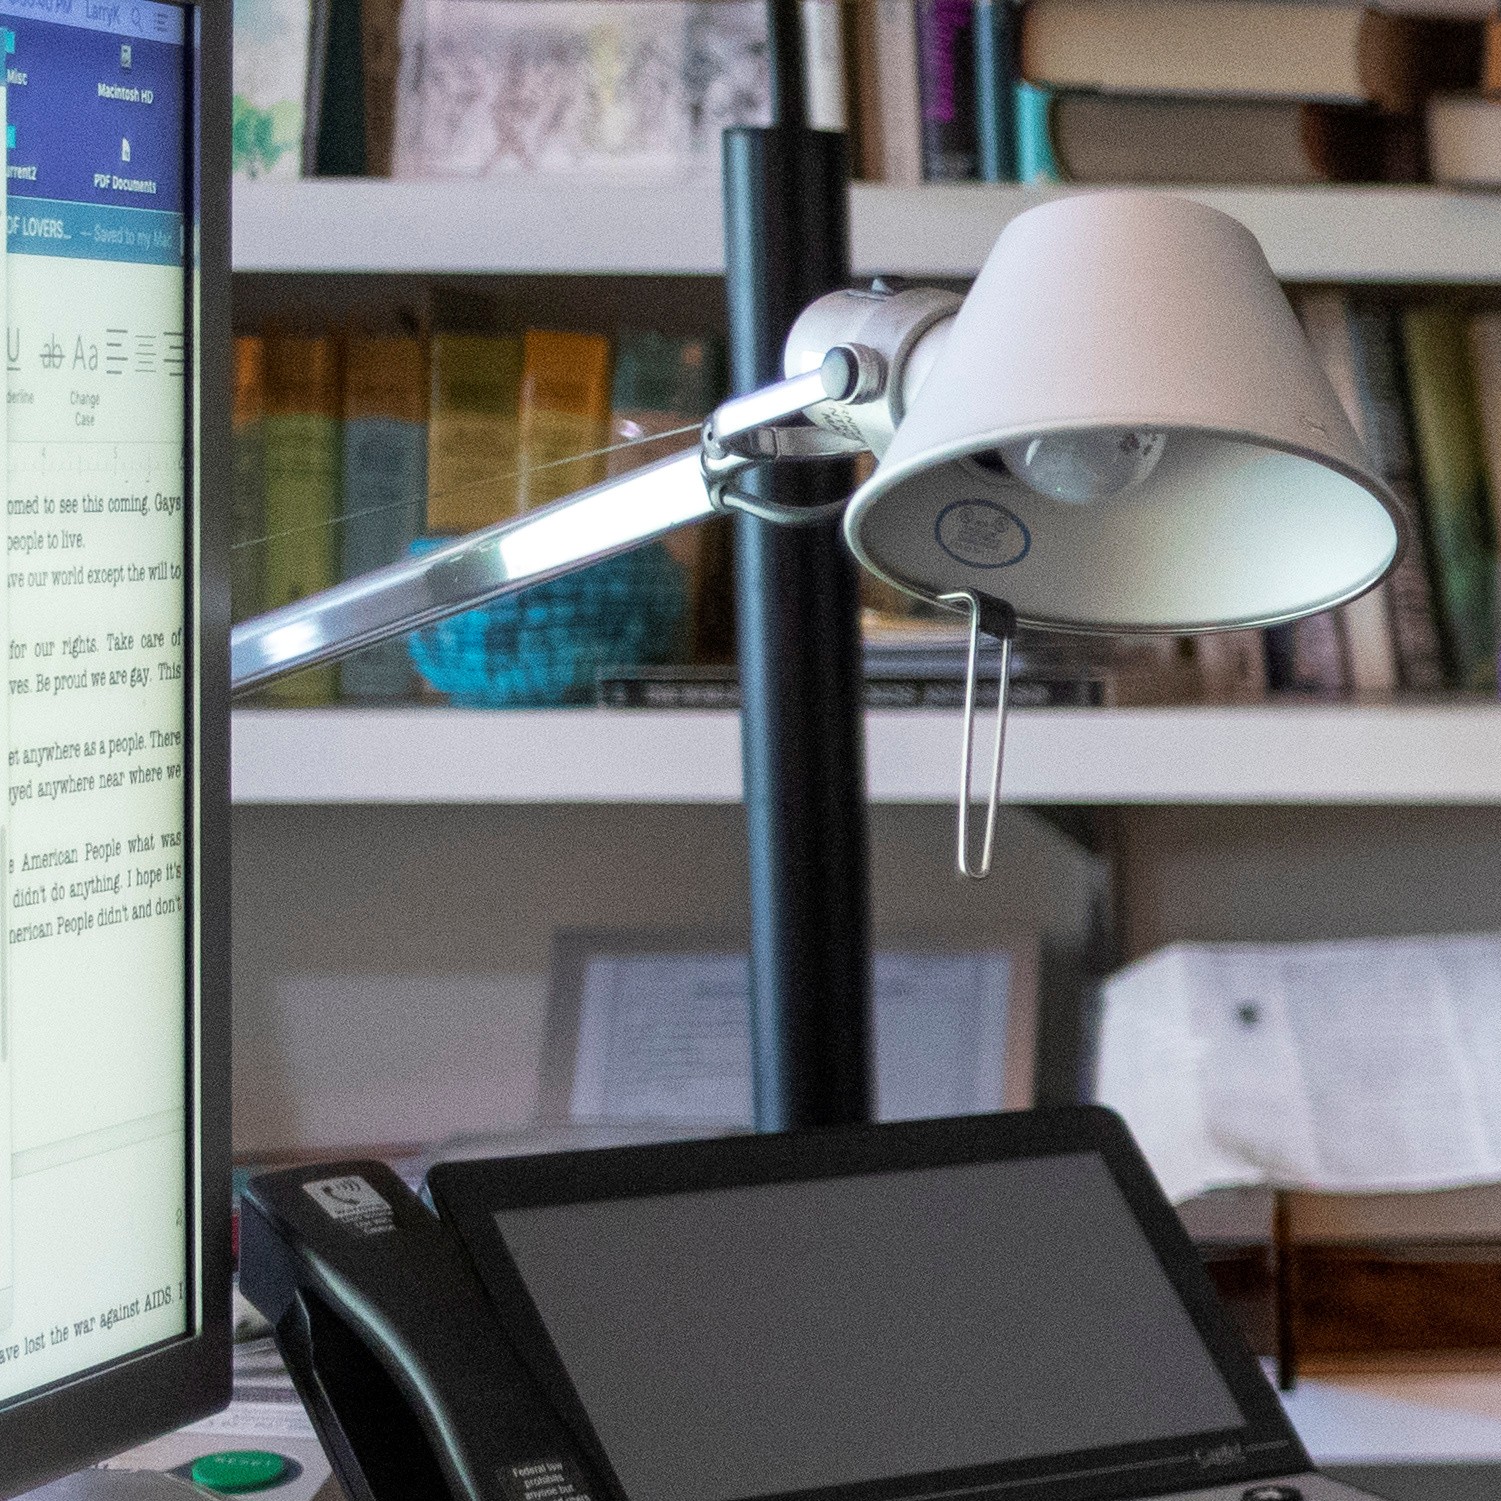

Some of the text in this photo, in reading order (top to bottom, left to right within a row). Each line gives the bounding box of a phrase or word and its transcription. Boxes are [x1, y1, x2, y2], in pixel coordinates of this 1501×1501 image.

[98, 83, 154, 104] Macintosh HD
[94, 173, 157, 194] PDF Documents
[125, 228, 135, 245] to
[70, 390, 100, 409] Change
[75, 411, 95, 426] Case
[44, 496, 55, 514] to
[59, 499, 79, 513] see
[82, 494, 104, 513] this
[7, 530, 44, 555] people
[47, 531, 59, 549] to
[27, 570, 48, 587] our
[51, 566, 84, 586] world
[87, 564, 125, 588] except
[127, 563, 146, 582] the
[148, 561, 168, 580] will
[170, 562, 182, 580] to
[8, 639, 28, 659] for
[34, 640, 55, 657] our
[106, 632, 134, 651] Take
[140, 632, 165, 649] care
[171, 627, 182, 647] of
[35, 673, 50, 693] Be
[54, 669, 88, 696] proud
[91, 671, 106, 687] we
[109, 670, 128, 686] are
[157, 661, 182, 682] This
[22, 741, 81, 767] anywhere
[83, 741, 97, 757] as
[99, 740, 106, 755] a
[149, 729, 182, 748] There
[37, 774, 95, 801] anywhere
[99, 771, 125, 789] near
[129, 765, 163, 784] where
[166, 763, 182, 779] we
[21, 847, 78, 872] American
[84, 838, 122, 863] People
[127, 833, 155, 854] what
[161, 831, 182, 848] was
[12, 885, 46, 909] didn't
[51, 883, 65, 902] do
[127, 870, 133, 887] I
[135, 867, 163, 888] hope
[166, 863, 182, 881] it's
[57, 911, 94, 936] People
[97, 904, 129, 927] didn't
[132, 898, 152, 920] and
[155, 895, 182, 915] don't
[24, 1331, 46, 1354] lost
[51, 1323, 69, 1344] the
[73, 1317, 96, 1338] war
[99, 1299, 140, 1330] against
